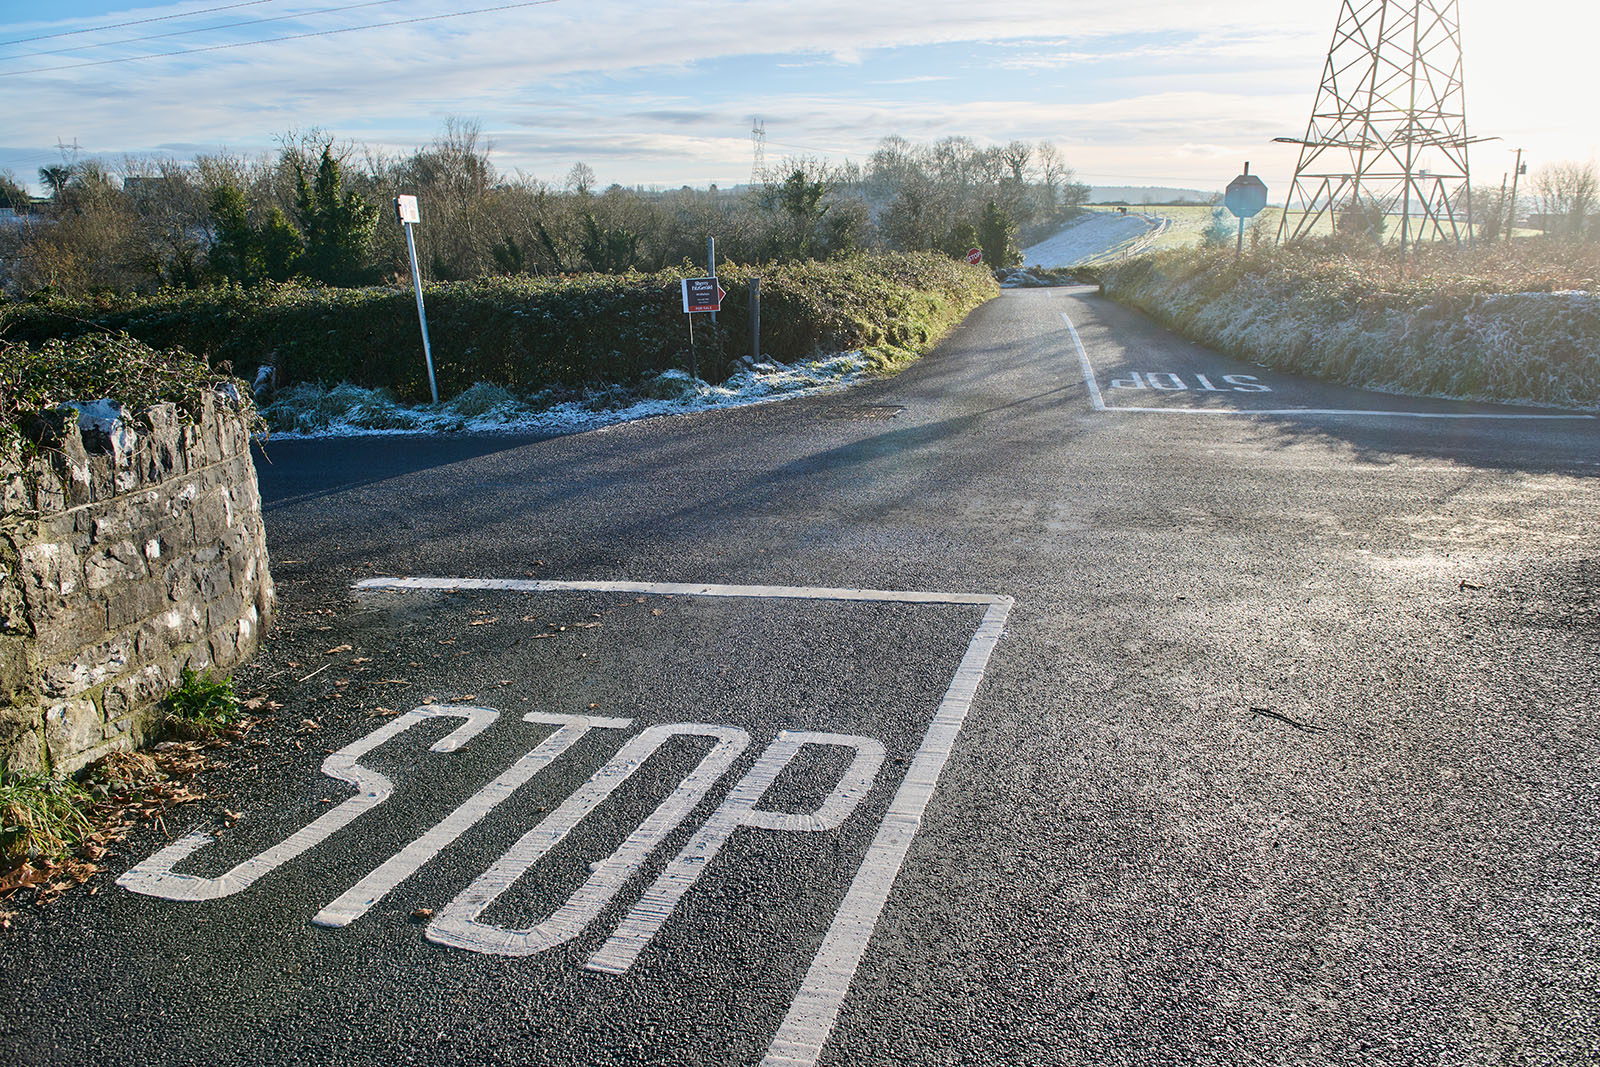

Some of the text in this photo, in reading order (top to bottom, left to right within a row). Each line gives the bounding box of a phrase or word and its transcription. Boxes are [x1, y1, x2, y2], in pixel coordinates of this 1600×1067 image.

[968, 252, 981, 261] STOP
[1111, 371, 1272, 392] STOP
[117, 704, 886, 974] STOP
